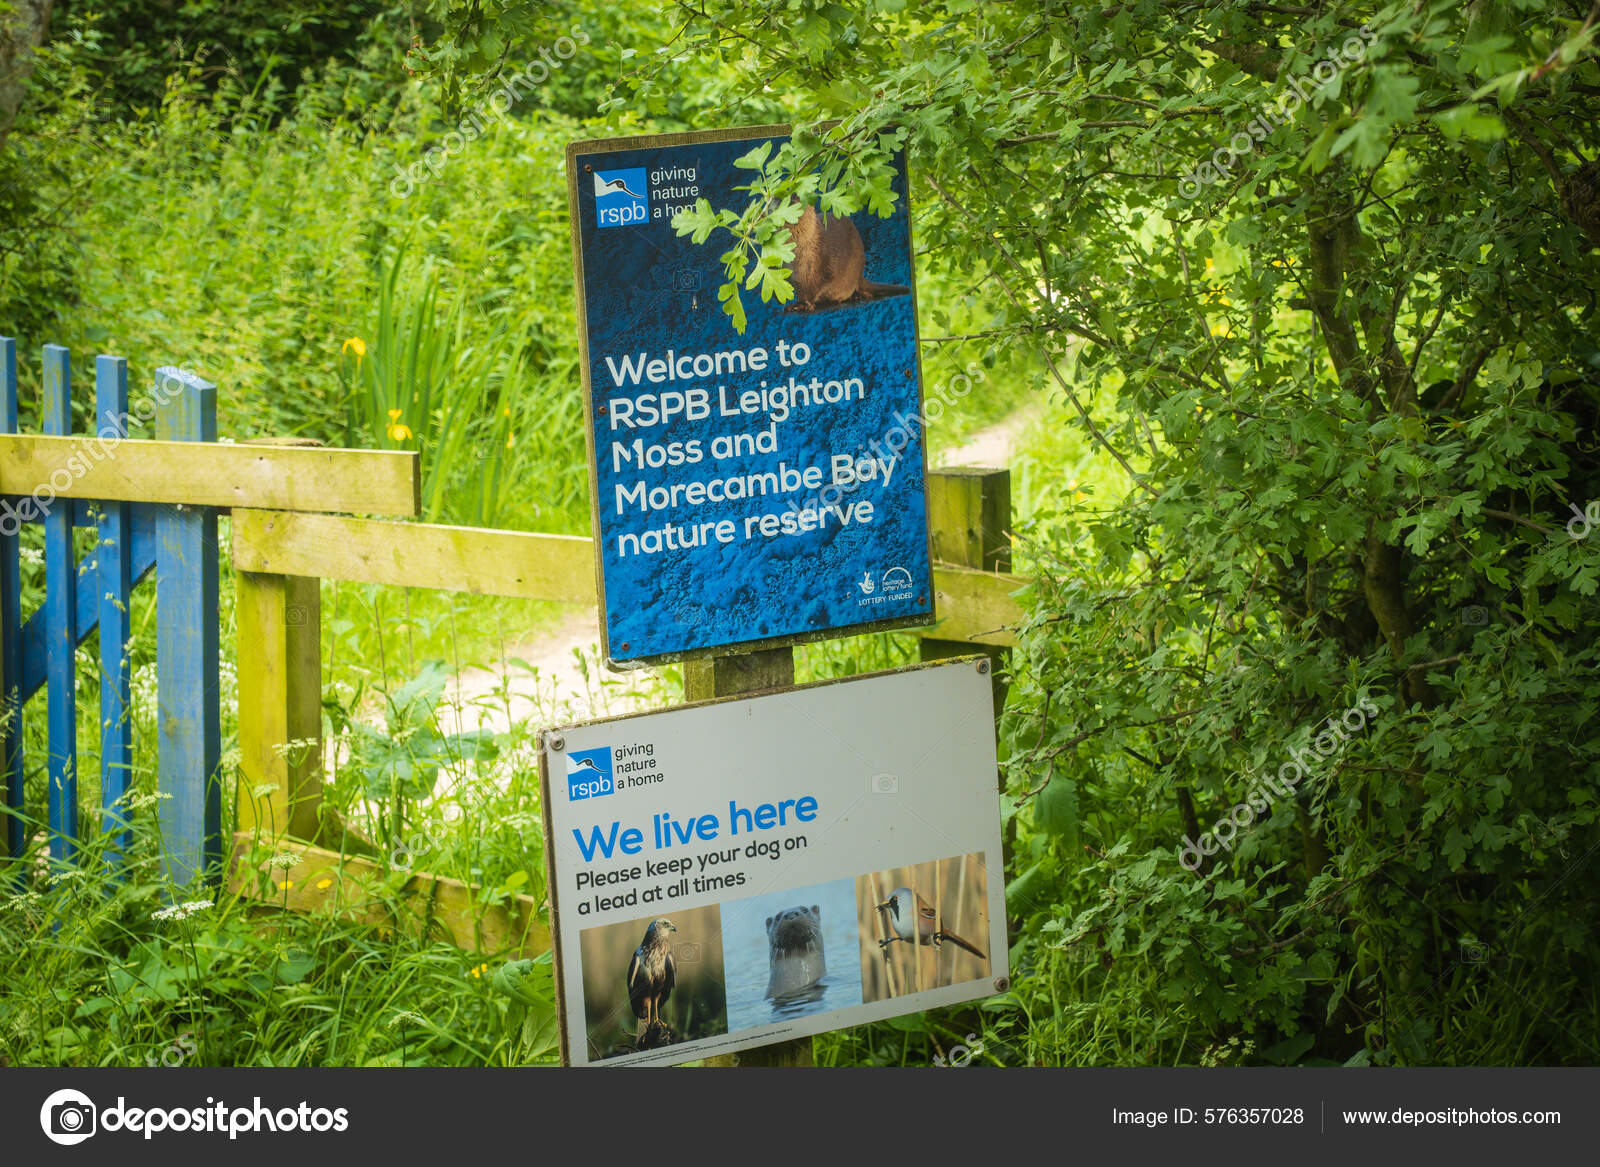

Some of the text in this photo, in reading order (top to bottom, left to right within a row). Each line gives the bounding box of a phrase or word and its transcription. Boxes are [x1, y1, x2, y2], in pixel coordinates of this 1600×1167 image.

[651, 166, 696, 186] giving
[652, 185, 699, 201] nature
[600, 200, 646, 226] rspb
[653, 203, 697, 218] a hom
[605, 339, 811, 387] Welcome to
[609, 375, 865, 430] RSPB Leighton
[611, 422, 778, 473] Moss and
[615, 453, 897, 515] Morecambe Bay
[617, 499, 875, 557] nature reserve
[859, 592, 912, 606] LOTTERY FUNDED
[615, 743, 654, 762] giving
[616, 757, 657, 774] nature
[571, 775, 611, 798] rspb
[617, 771, 664, 789] a home
[572, 795, 819, 862] We live here
[576, 834, 808, 890] Please keep your dog on
[577, 871, 746, 916] a lead at all times
